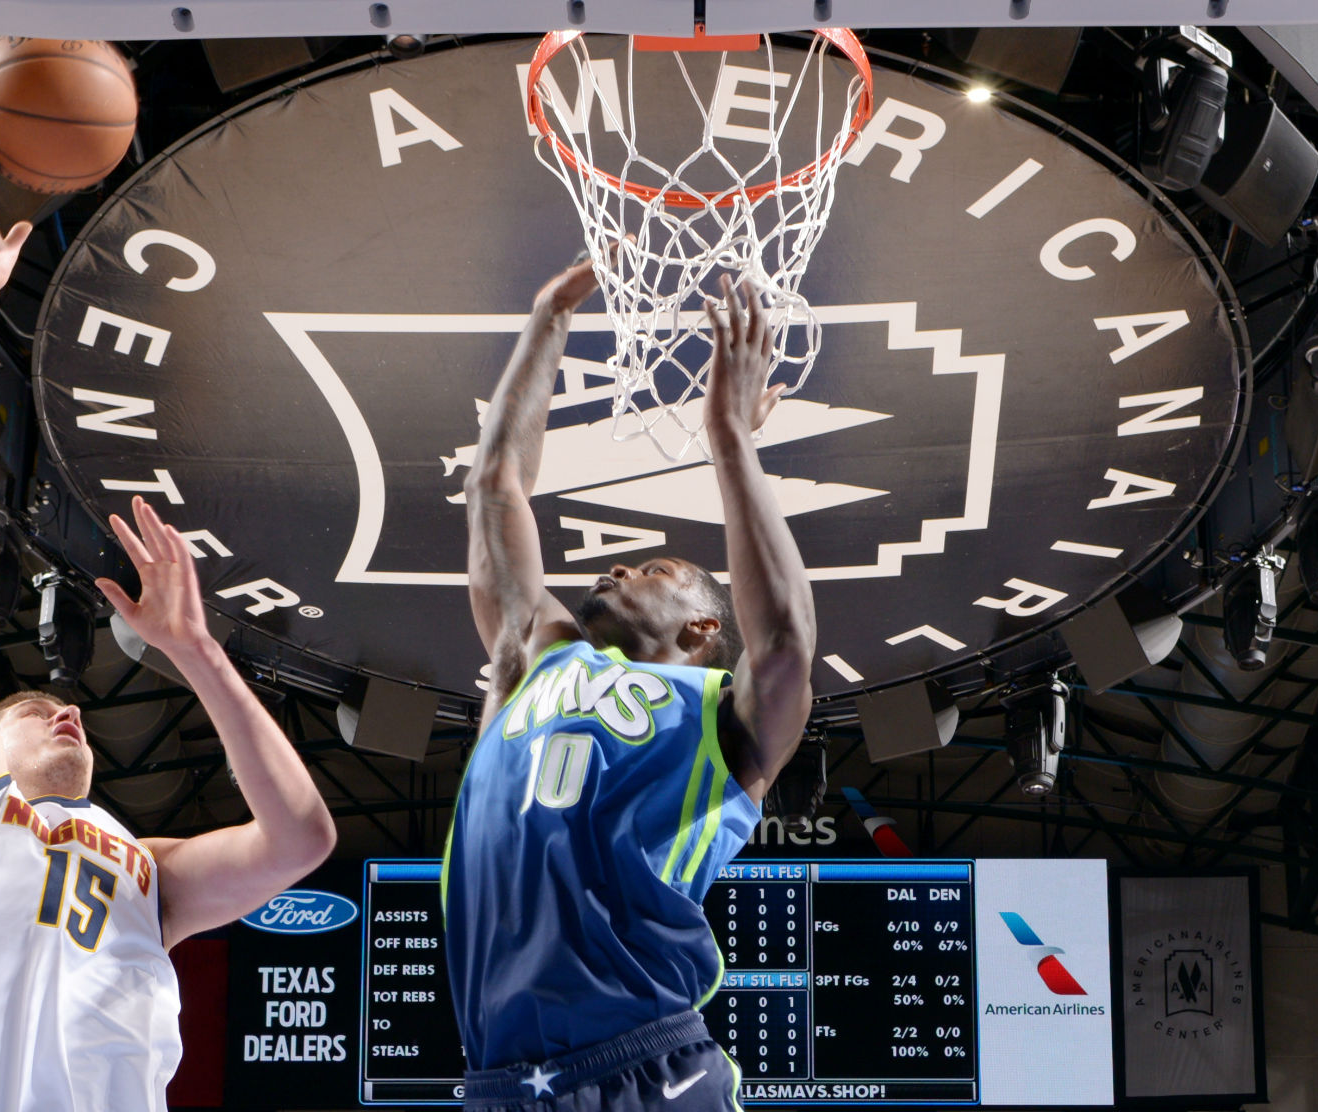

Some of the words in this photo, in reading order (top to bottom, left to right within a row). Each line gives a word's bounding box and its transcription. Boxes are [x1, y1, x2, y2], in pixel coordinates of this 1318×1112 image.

[501, 657, 673, 746] MAVS
[521, 732, 593, 812] 10
[1, 794, 151, 898] NUGGETS
[718, 867, 745, 878] AST
[750, 867, 774, 878] STL
[778, 867, 802, 878] FLS
[36, 846, 118, 953] 15
[728, 889, 737, 899] 2
[758, 889, 765, 899] 1
[786, 889, 795, 899] 0
[887, 889, 916, 900] DAL
[929, 889, 960, 900] DEN
[260, 896, 334, 925] Ford
[374, 911, 428, 922] ASSISTS
[815, 921, 839, 932] FGs
[887, 921, 920, 932] 6/10
[934, 921, 958, 932] 6/9
[374, 938, 400, 949] OFF
[405, 938, 438, 949] REBS
[893, 940, 923, 951] 60%
[938, 940, 968, 951] 67%
[373, 965, 398, 976] DEF
[402, 965, 435, 976] REBS
[258, 967, 335, 993] TEXAS
[750, 975, 774, 986] STL
[779, 975, 803, 986] FLS
[815, 975, 840, 986] 3PT
[845, 975, 869, 986] FGs
[892, 975, 916, 987] 2/4
[935, 975, 959, 987] 0/2
[373, 991, 397, 1002] TOT
[402, 991, 435, 1002] REBS
[728, 997, 737, 1007] 0
[758, 997, 767, 1007] 0
[788, 997, 794, 1007] 1
[894, 995, 924, 1005] 50%
[943, 995, 965, 1005] 0%
[266, 1001, 327, 1027] FORD
[985, 1003, 1050, 1016] American
[1053, 1003, 1105, 1016] Airlines
[373, 1019, 391, 1030] TO
[815, 1026, 836, 1037] FTs
[893, 1027, 917, 1038] 2/2
[936, 1027, 960, 1038] 0/0
[243, 1035, 346, 1062] DEALERS
[372, 1046, 419, 1057] STEALS
[891, 1046, 929, 1057] 100%
[944, 1046, 966, 1057] 0%
